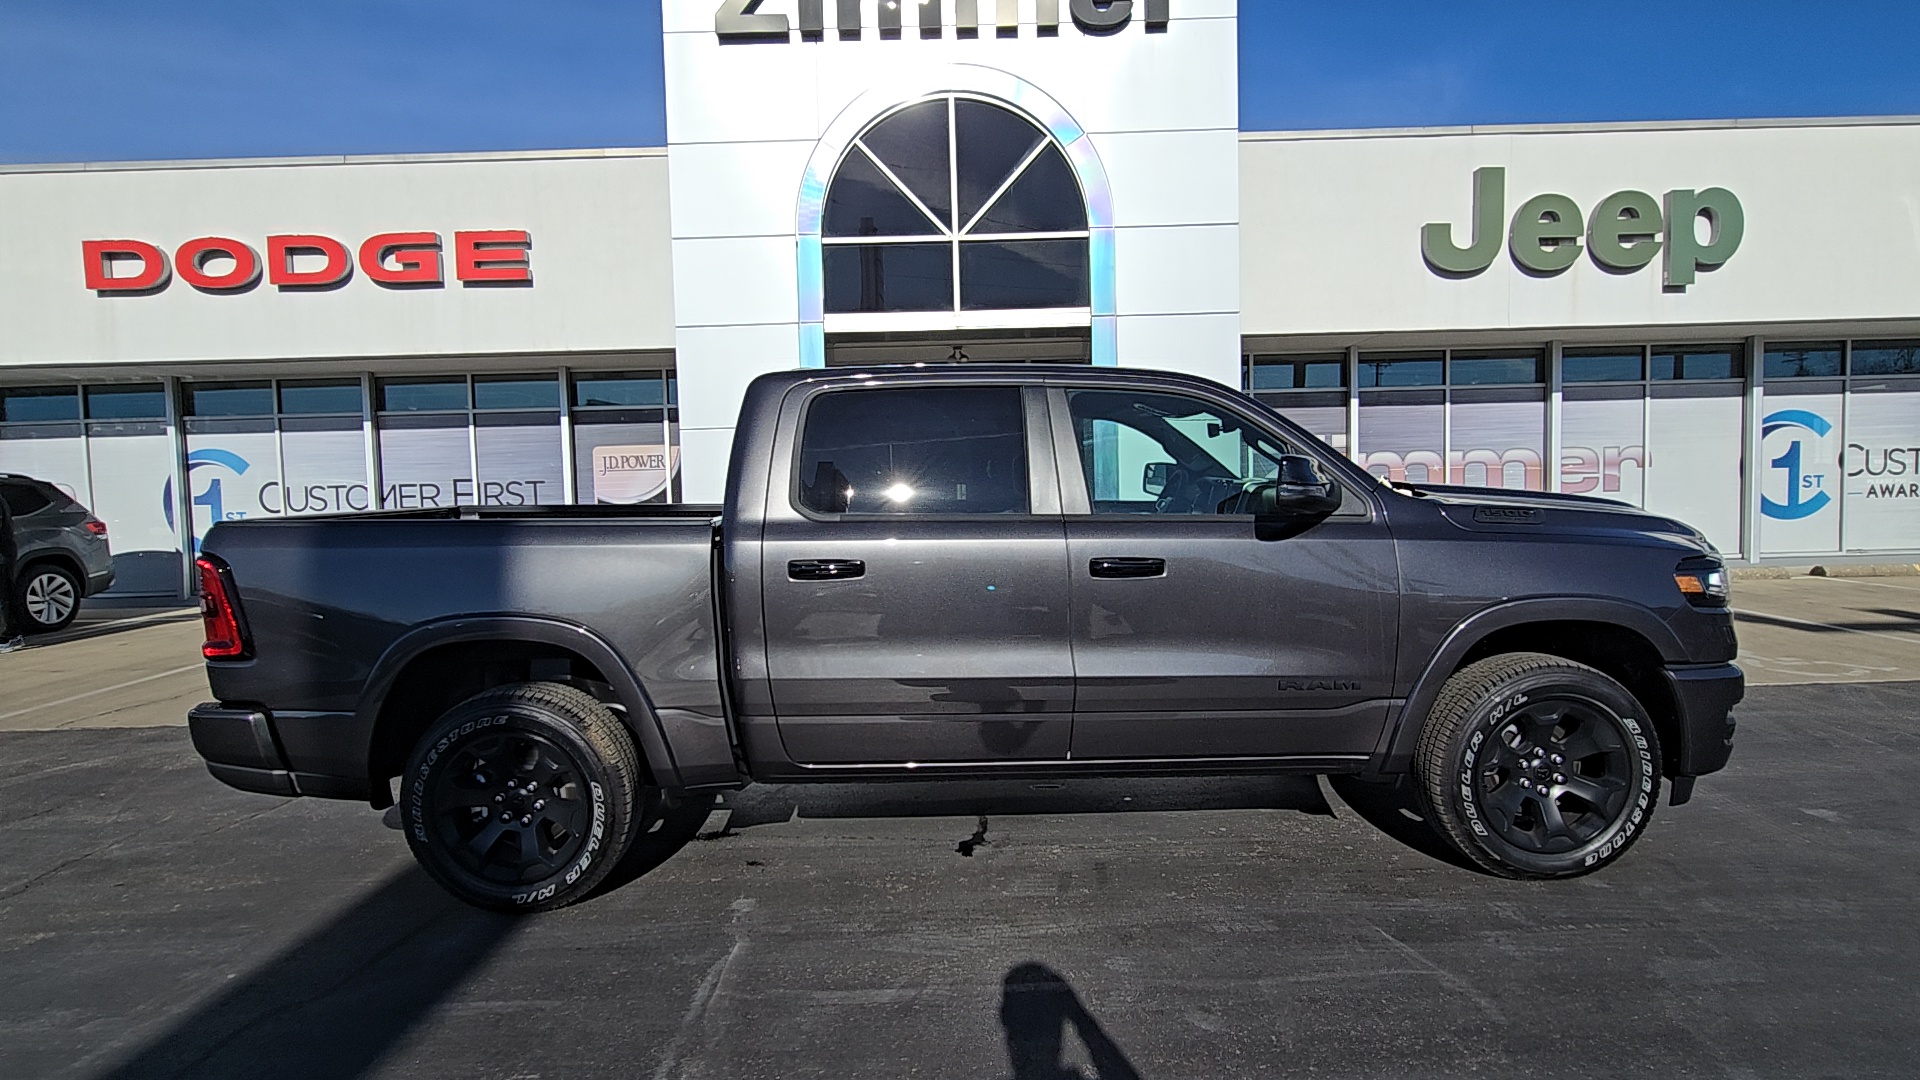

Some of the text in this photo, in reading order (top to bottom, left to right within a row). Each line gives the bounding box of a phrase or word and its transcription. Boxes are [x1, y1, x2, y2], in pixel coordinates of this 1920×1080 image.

[82, 230, 533, 291] DODGE
[1421, 167, 1744, 285] Jeep
[621, 455, 667, 469] POWER
[1278, 680, 1361, 691] RAM
[412, 715, 510, 843] BRIDGESTONE
[1461, 731, 1489, 836] DUELER
[1584, 718, 1653, 866] BRIDGESTONE
[565, 781, 605, 884] DUELER
